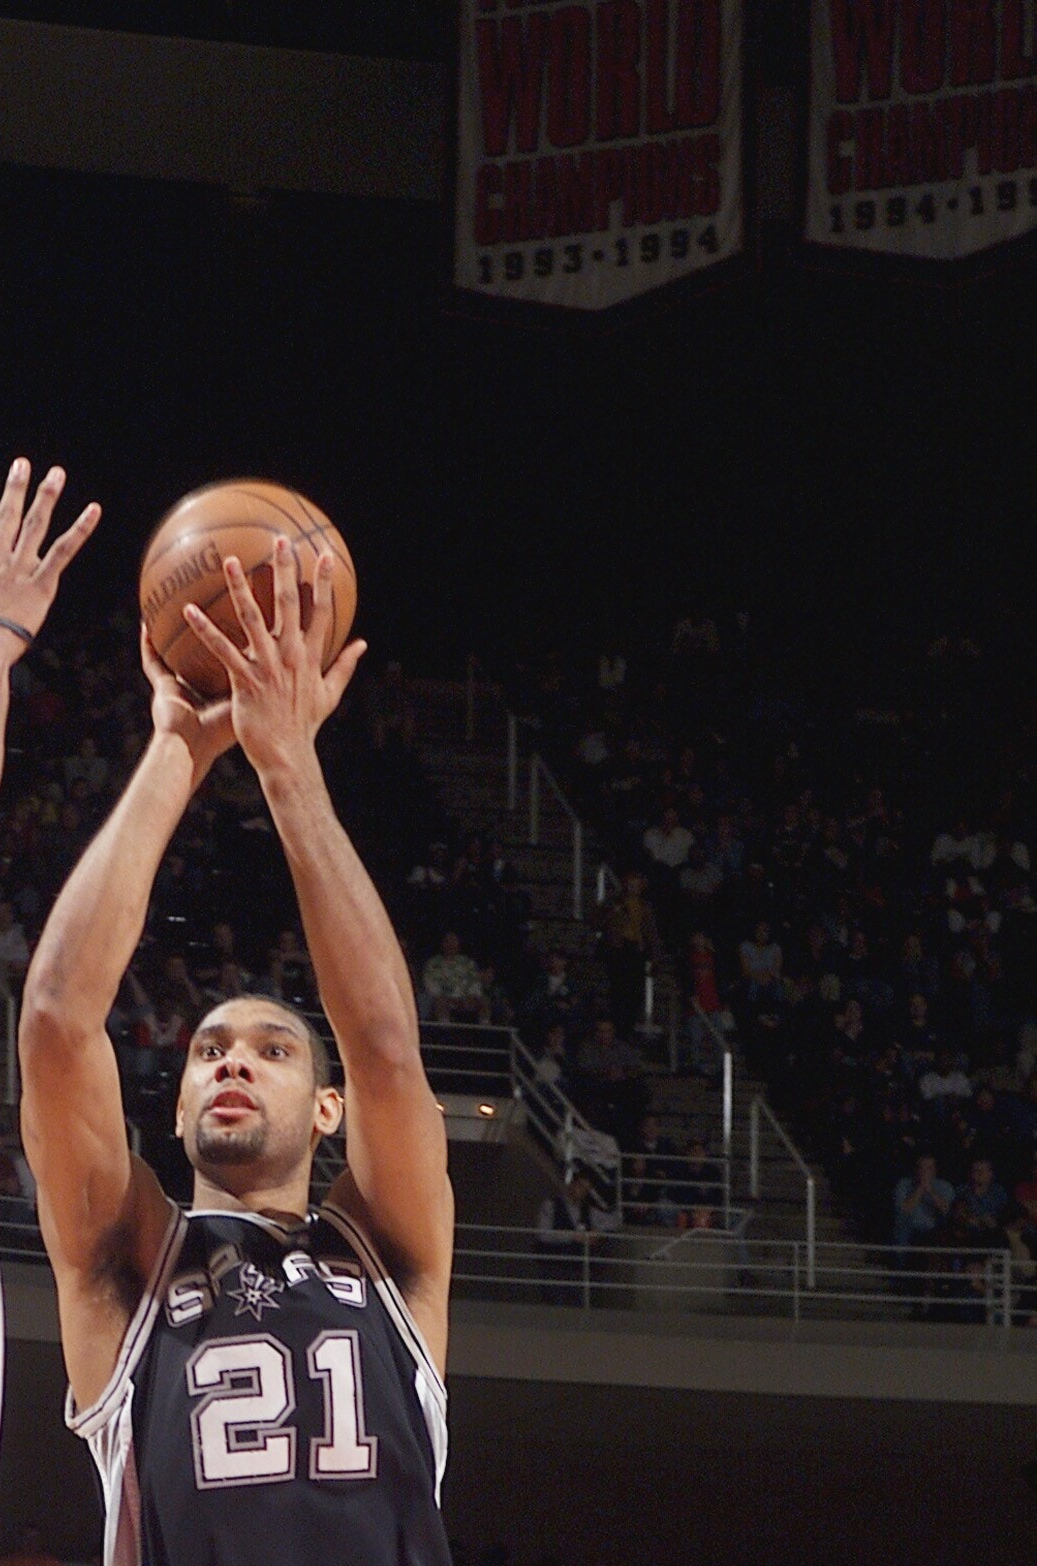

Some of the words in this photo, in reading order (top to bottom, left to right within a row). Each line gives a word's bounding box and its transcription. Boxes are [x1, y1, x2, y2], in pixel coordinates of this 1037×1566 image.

[476, 0, 721, 158] WORLD
[828, 0, 1037, 104] WORL
[185, 1329, 378, 1490] 21
